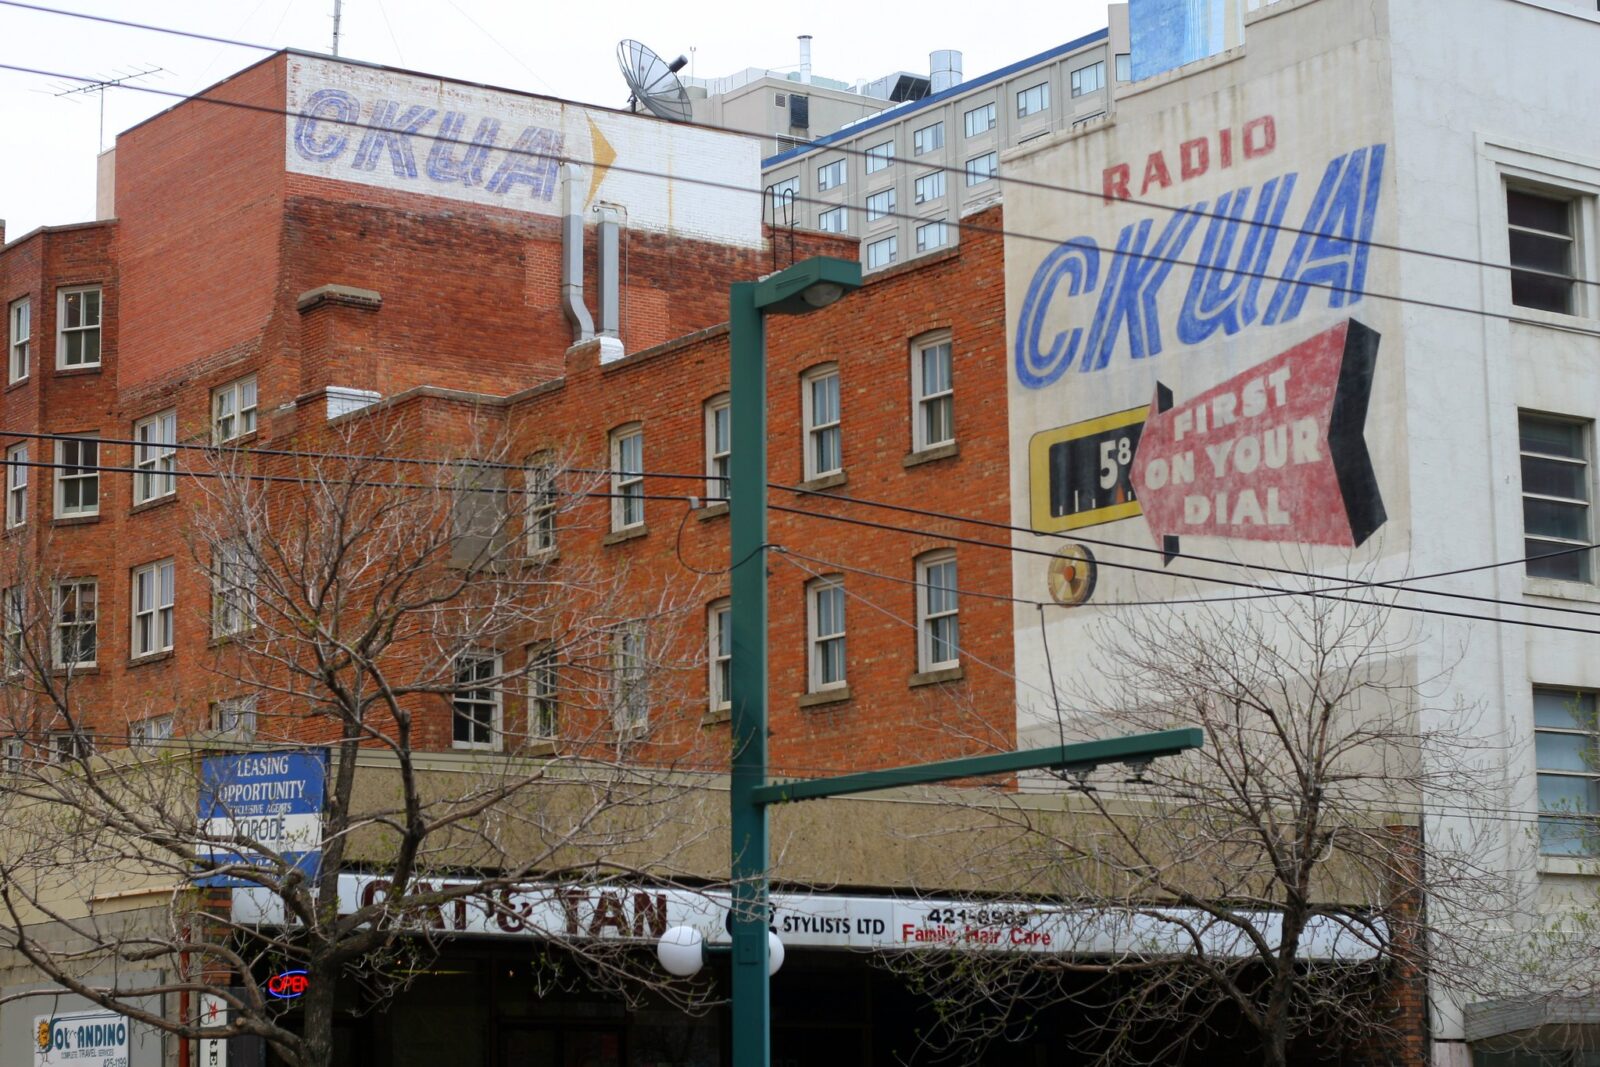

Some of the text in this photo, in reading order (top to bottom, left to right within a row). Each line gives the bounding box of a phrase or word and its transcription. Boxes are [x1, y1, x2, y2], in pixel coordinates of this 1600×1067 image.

[294, 88, 564, 202] CKUA
[1102, 114, 1277, 207] RADIO
[1015, 143, 1386, 391] CKUA
[1173, 367, 1292, 441] FIRST
[1144, 416, 1322, 490] ON YOUR
[1184, 487, 1291, 526] DIAL
[237, 756, 289, 777] LEASING
[218, 780, 306, 802] OPPORTUNITY
[554, 887, 667, 938] TAN
[783, 916, 851, 934] STYLISTS
[857, 918, 885, 935] LTD
[1010, 927, 1051, 946] Care
[77, 1023, 126, 1048] ANDINO
